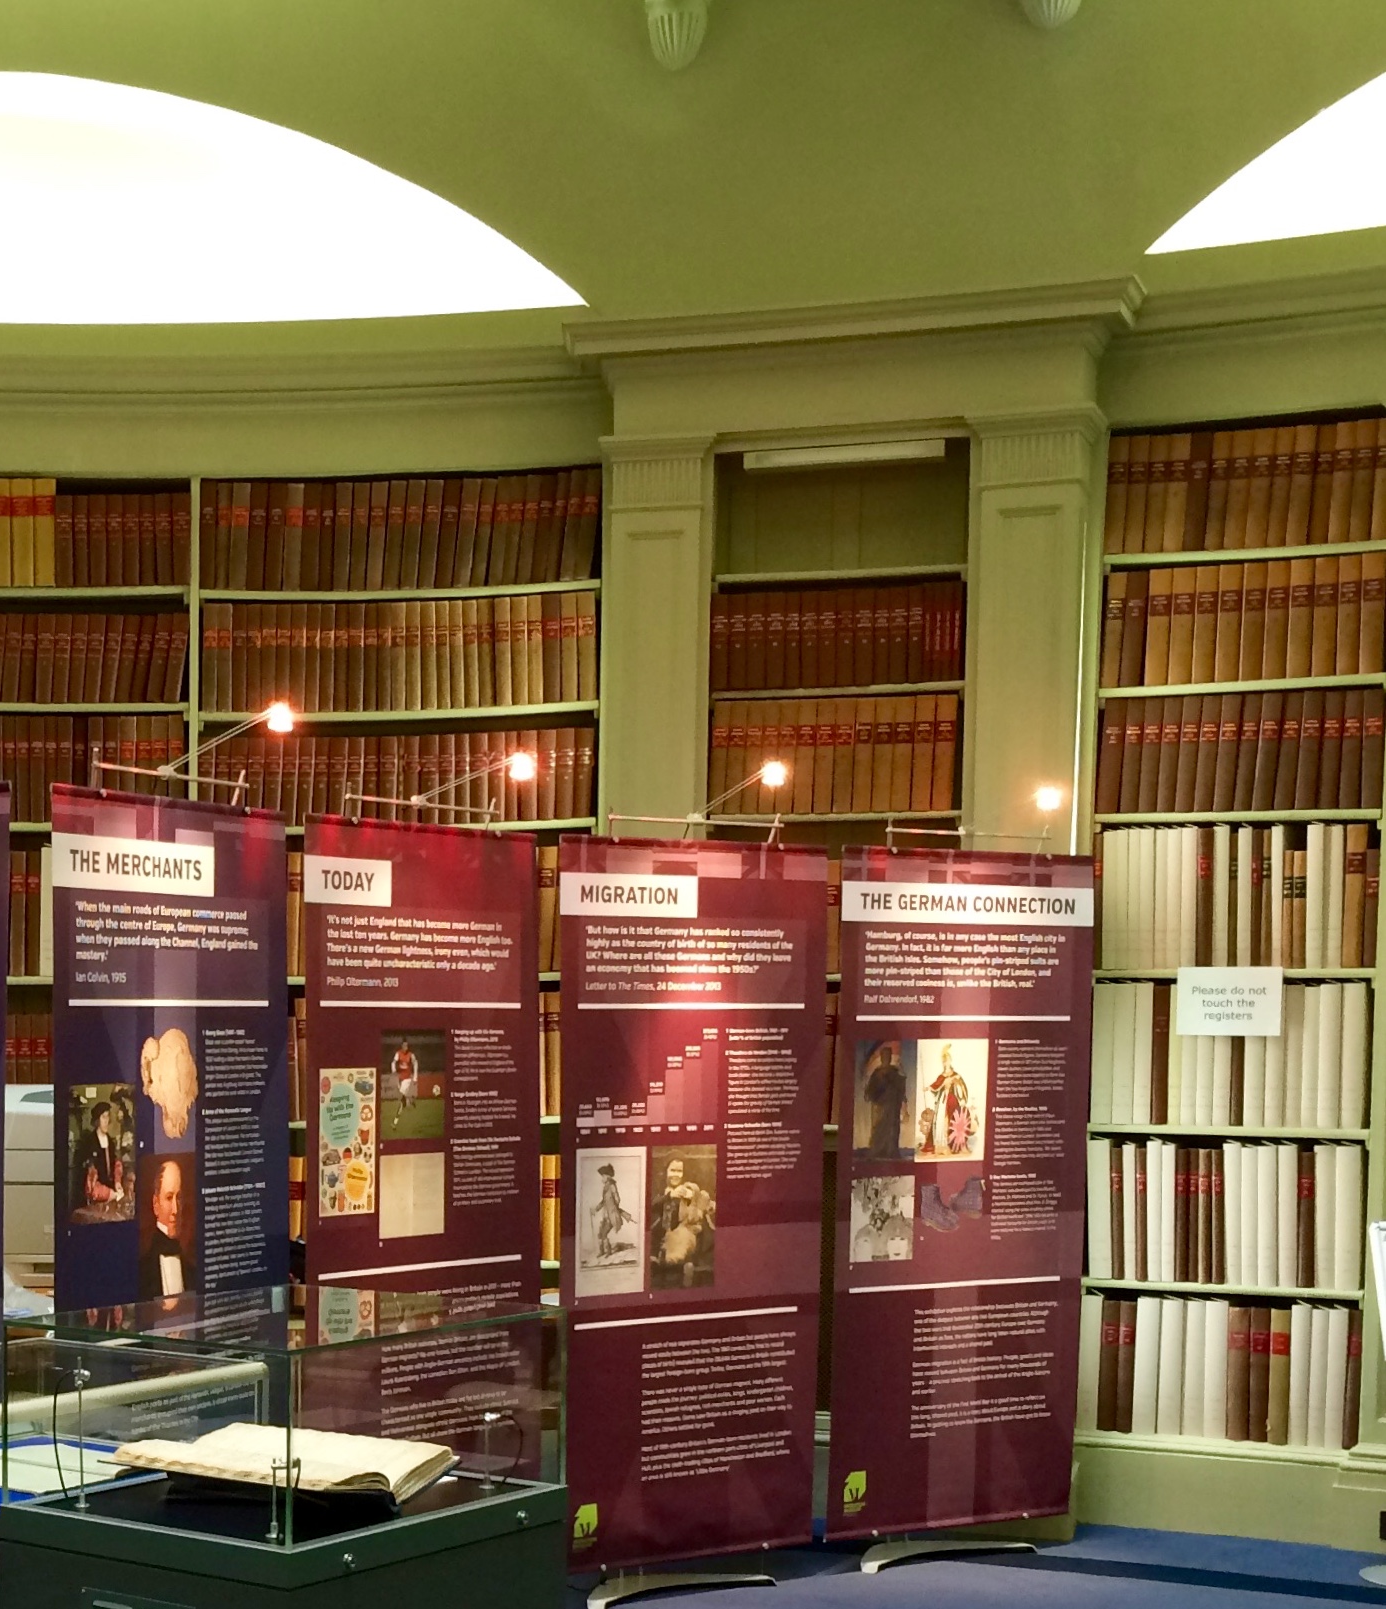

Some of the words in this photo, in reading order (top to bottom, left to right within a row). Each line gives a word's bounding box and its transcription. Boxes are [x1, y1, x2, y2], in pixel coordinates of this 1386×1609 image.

[70, 849, 101, 873] THE
[106, 852, 202, 880] MERCHANTS
[322, 869, 375, 892] TODAY
[580, 885, 678, 904] MIGRATION
[860, 893, 892, 910] THE
[898, 894, 967, 912] GERMAN
[973, 896, 1075, 914] CONNECTION
[1192, 986, 1227, 995] Please
[1230, 986, 1245, 995] do
[1248, 986, 1267, 995] not
[1202, 999, 1233, 1007] touch
[1236, 999, 1256, 1007] the
[1204, 1012, 1253, 1021] registers
